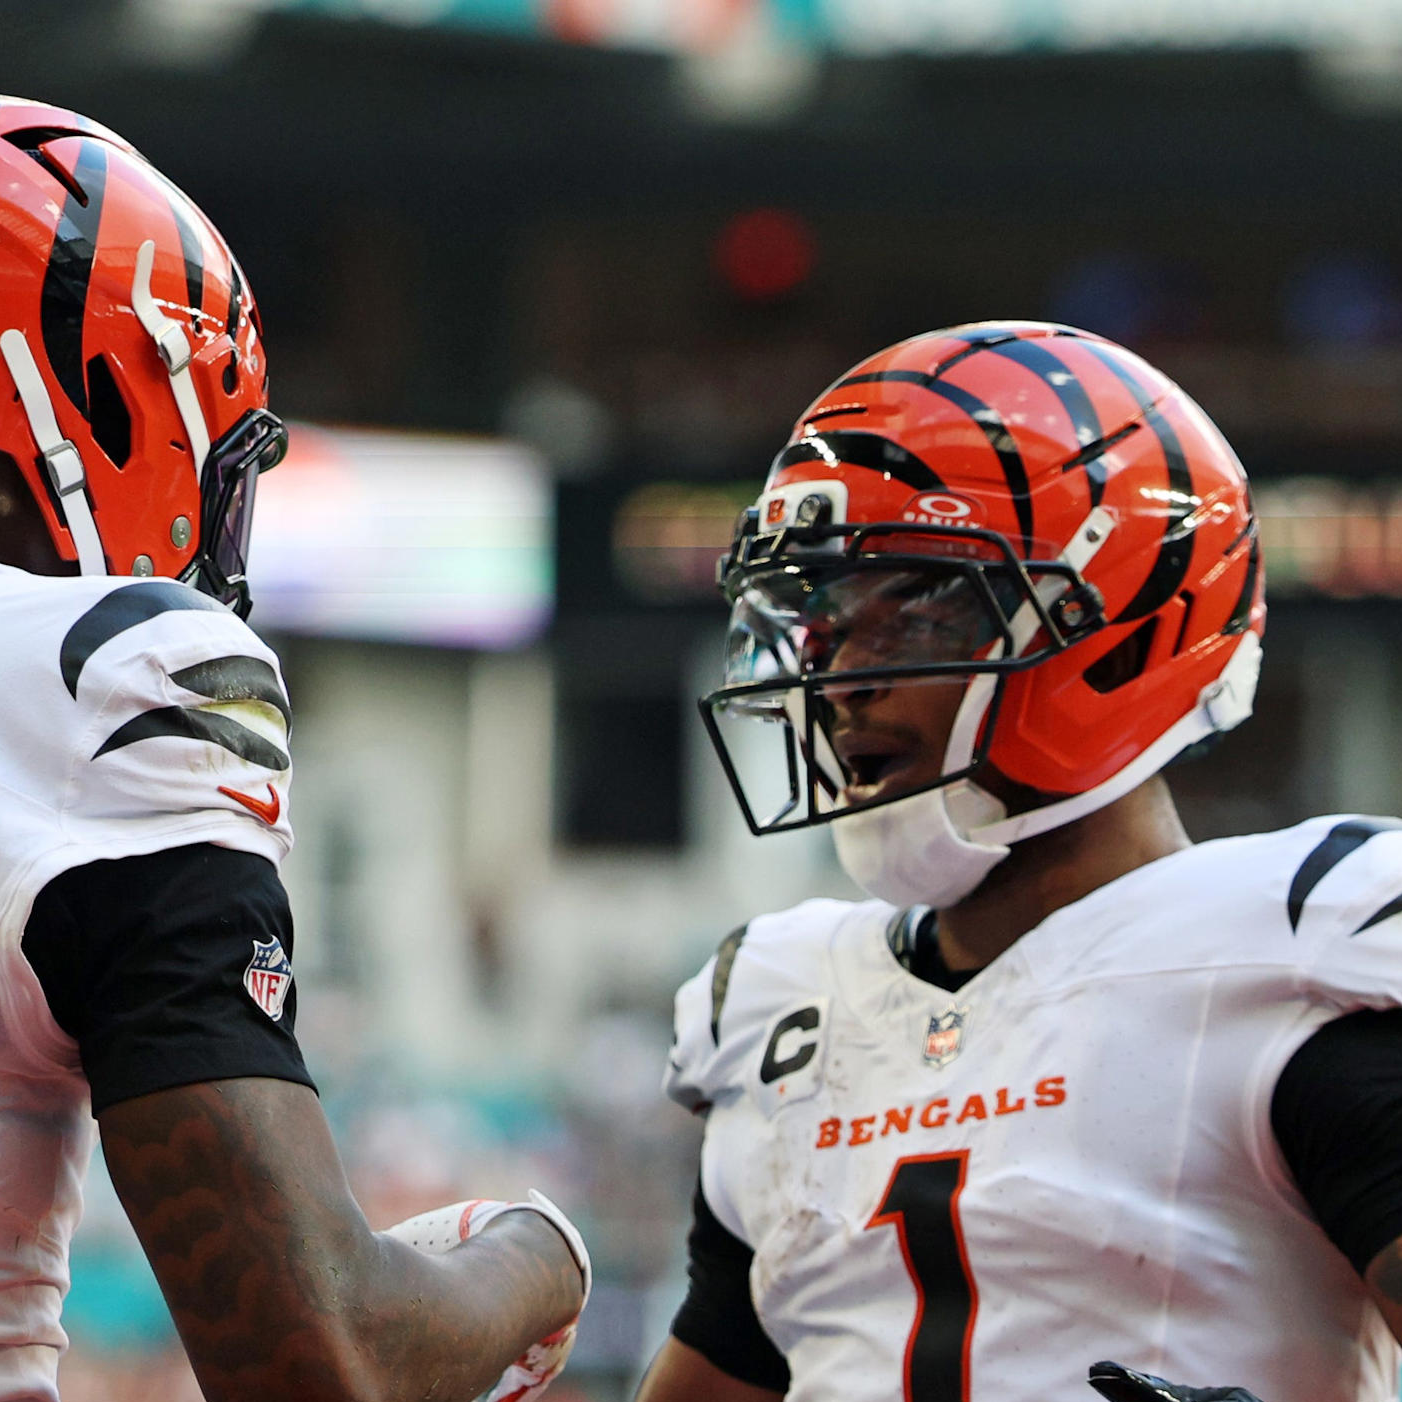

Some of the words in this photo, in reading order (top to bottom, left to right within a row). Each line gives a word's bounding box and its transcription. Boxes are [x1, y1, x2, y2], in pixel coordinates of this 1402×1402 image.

[250, 970, 286, 1013] NF
[760, 1006, 819, 1084] C
[815, 1076, 1068, 1149] BENGALS
